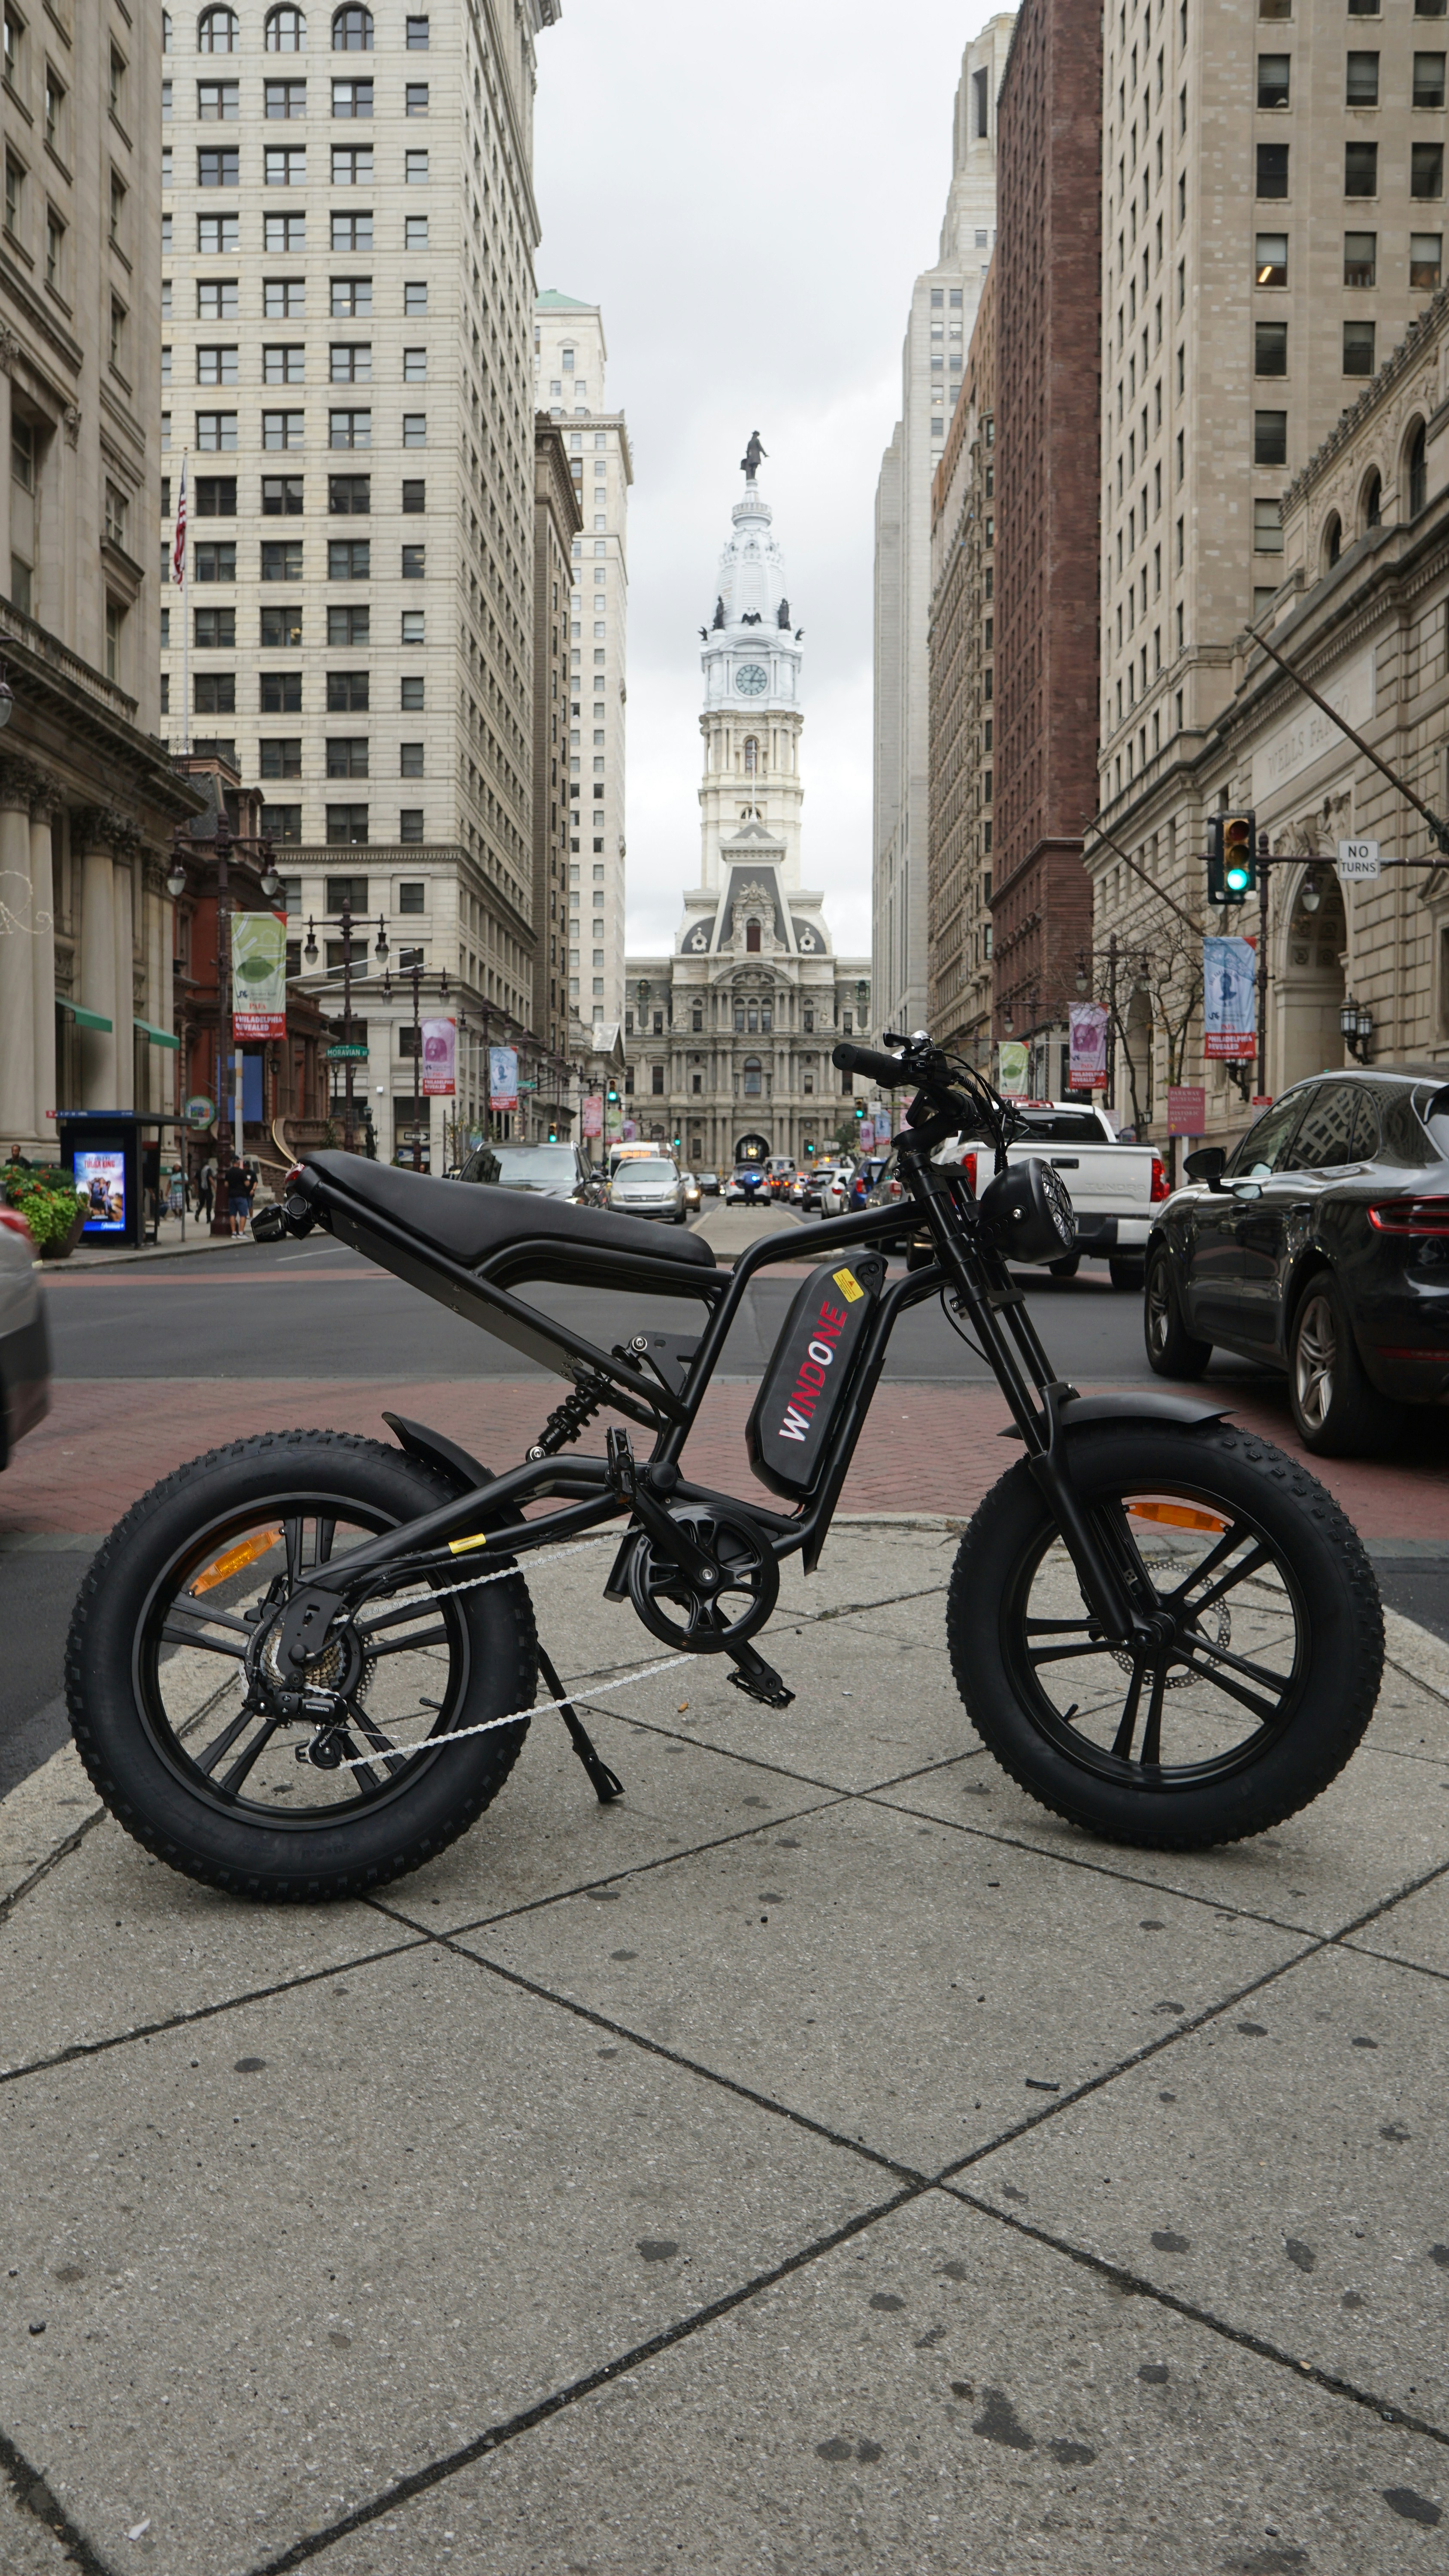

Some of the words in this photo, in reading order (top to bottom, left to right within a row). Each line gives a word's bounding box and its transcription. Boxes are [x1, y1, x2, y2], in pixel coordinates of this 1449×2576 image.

[1268, 731, 1304, 780] WELLS
[1348, 845, 1368, 858] NO
[1341, 862, 1376, 873] TURNS
[235, 1016, 283, 1024] PHILADELPHIA
[235, 1023, 269, 1031] REVEALED
[1085, 1183, 1146, 1193] TUNDRA
[778, 1300, 848, 1442] WINDONE
